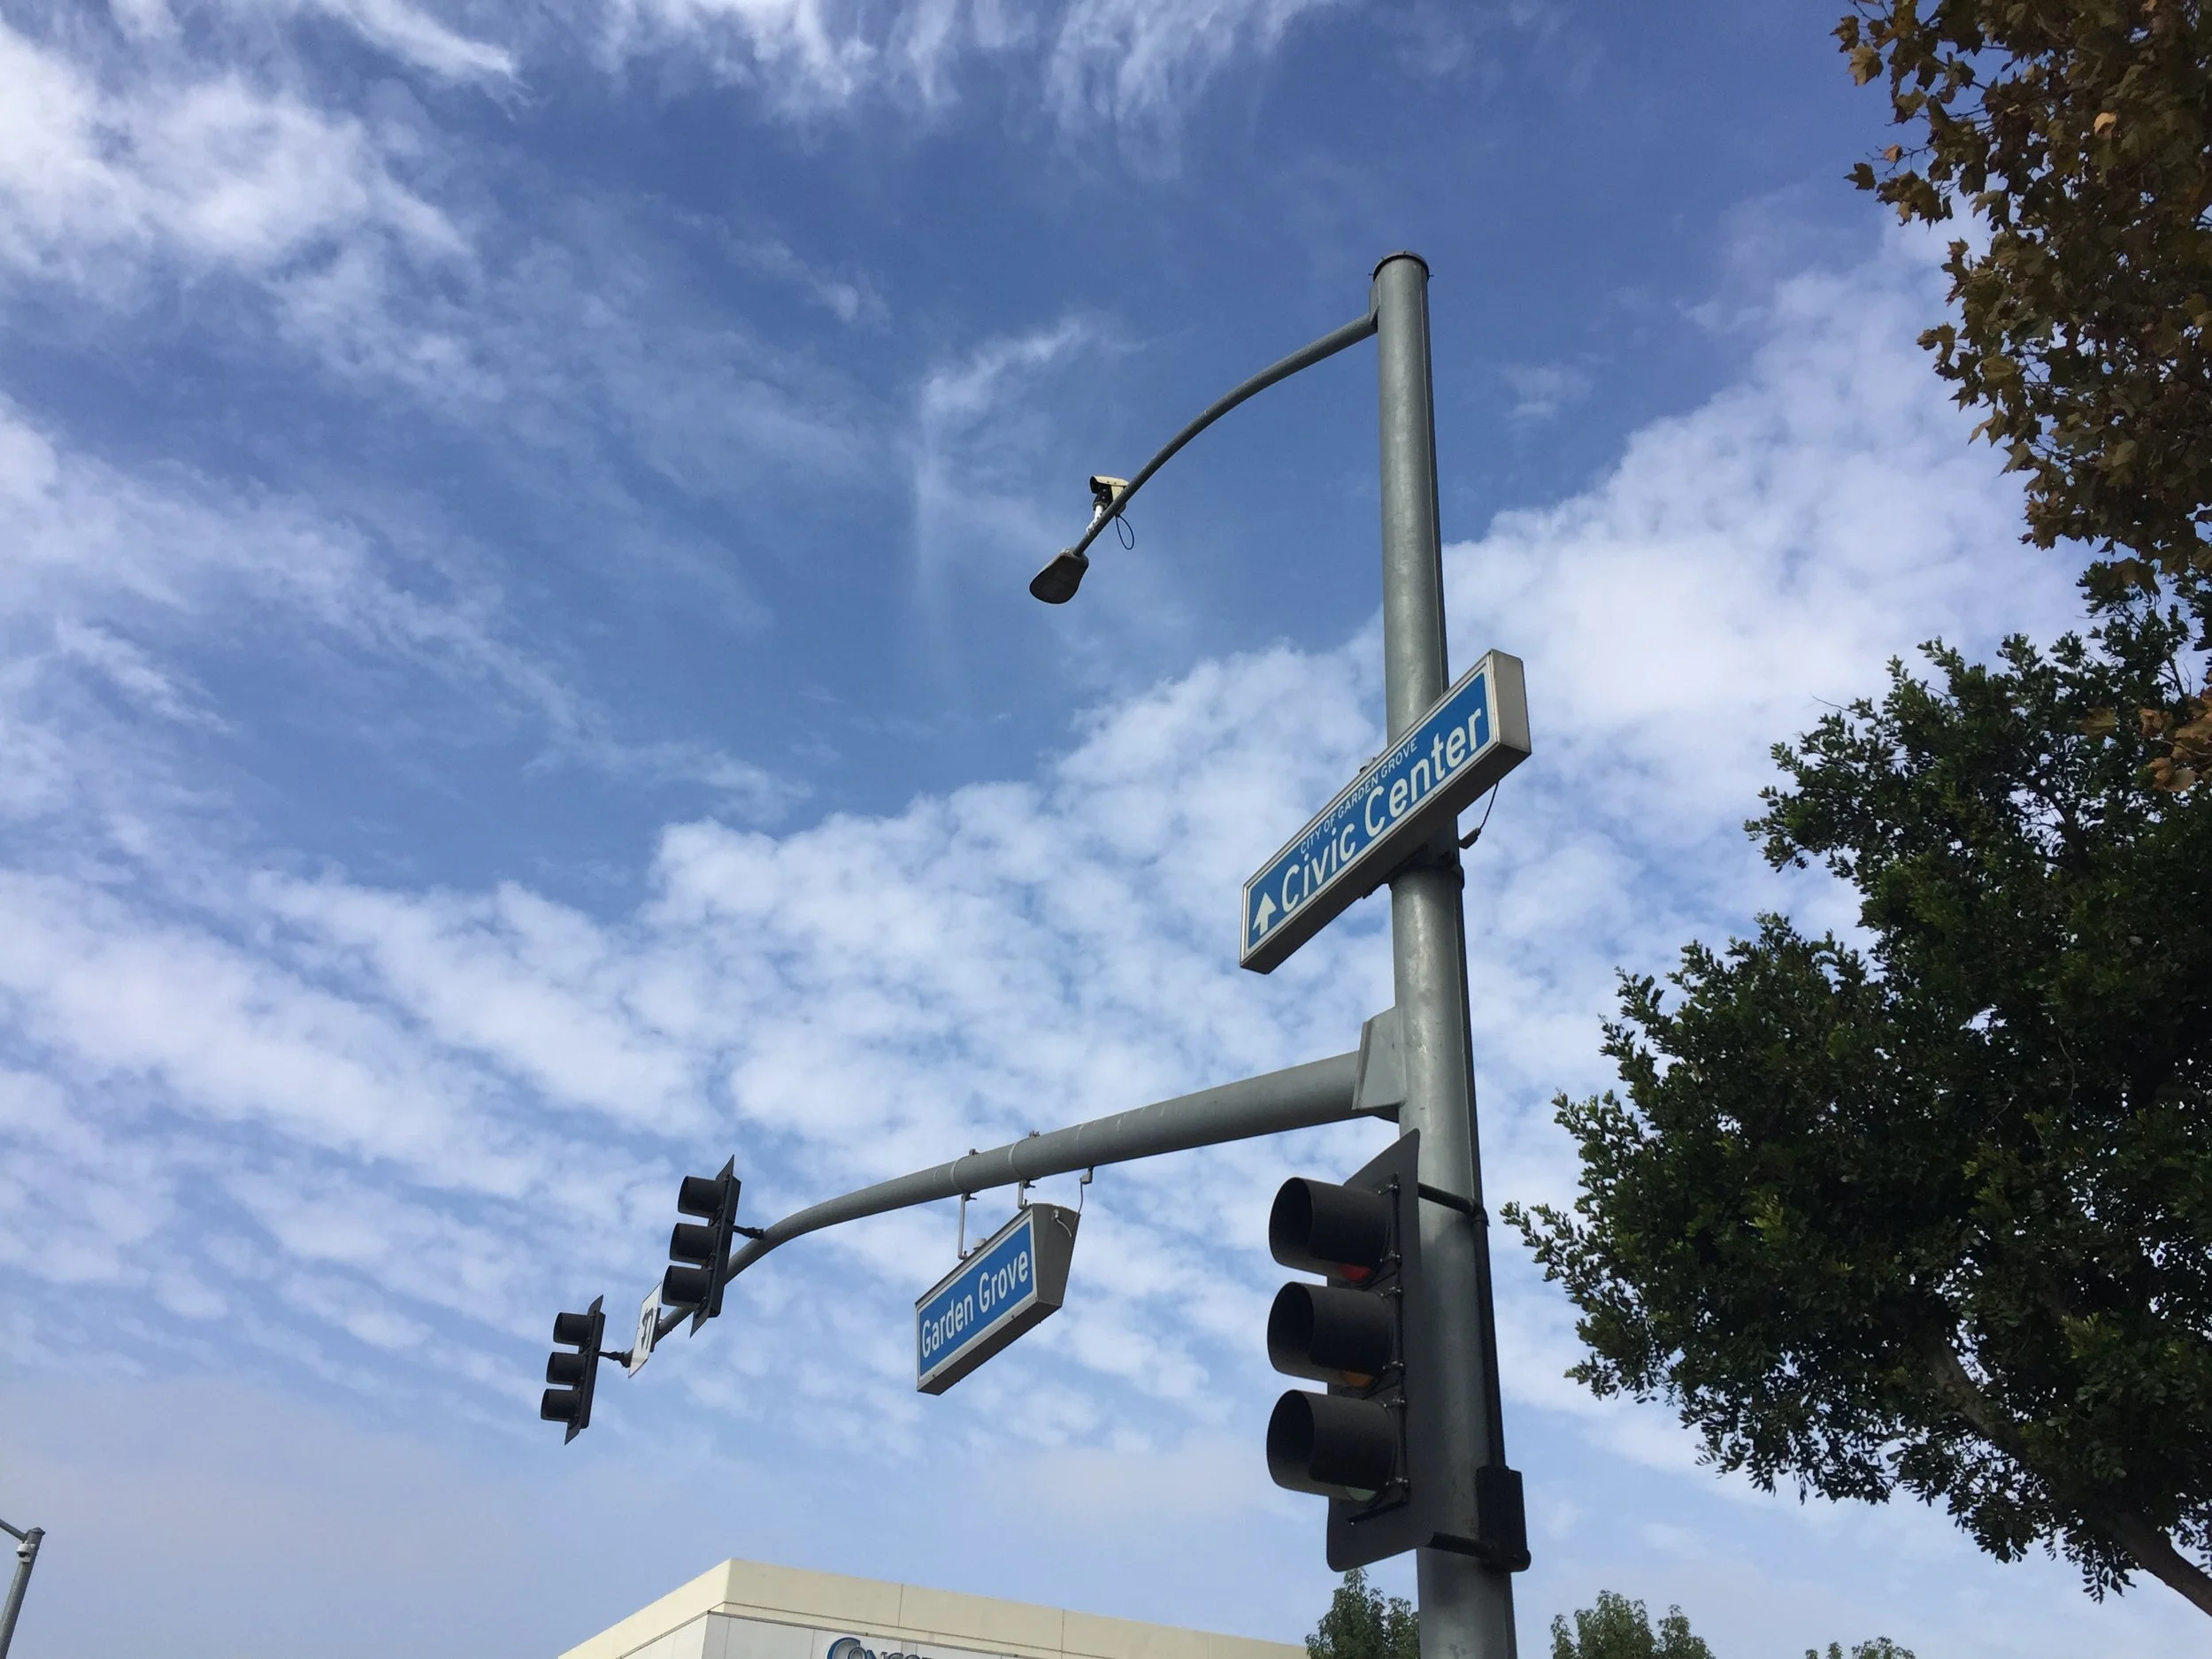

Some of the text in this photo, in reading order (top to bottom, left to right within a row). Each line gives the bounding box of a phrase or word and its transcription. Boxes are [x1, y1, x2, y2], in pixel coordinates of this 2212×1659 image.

[1281, 708, 1481, 914] Civic Center
[1300, 737, 1417, 855] CITY OF GARDEN GROVE
[922, 1250, 1029, 1358] Garden Grove
